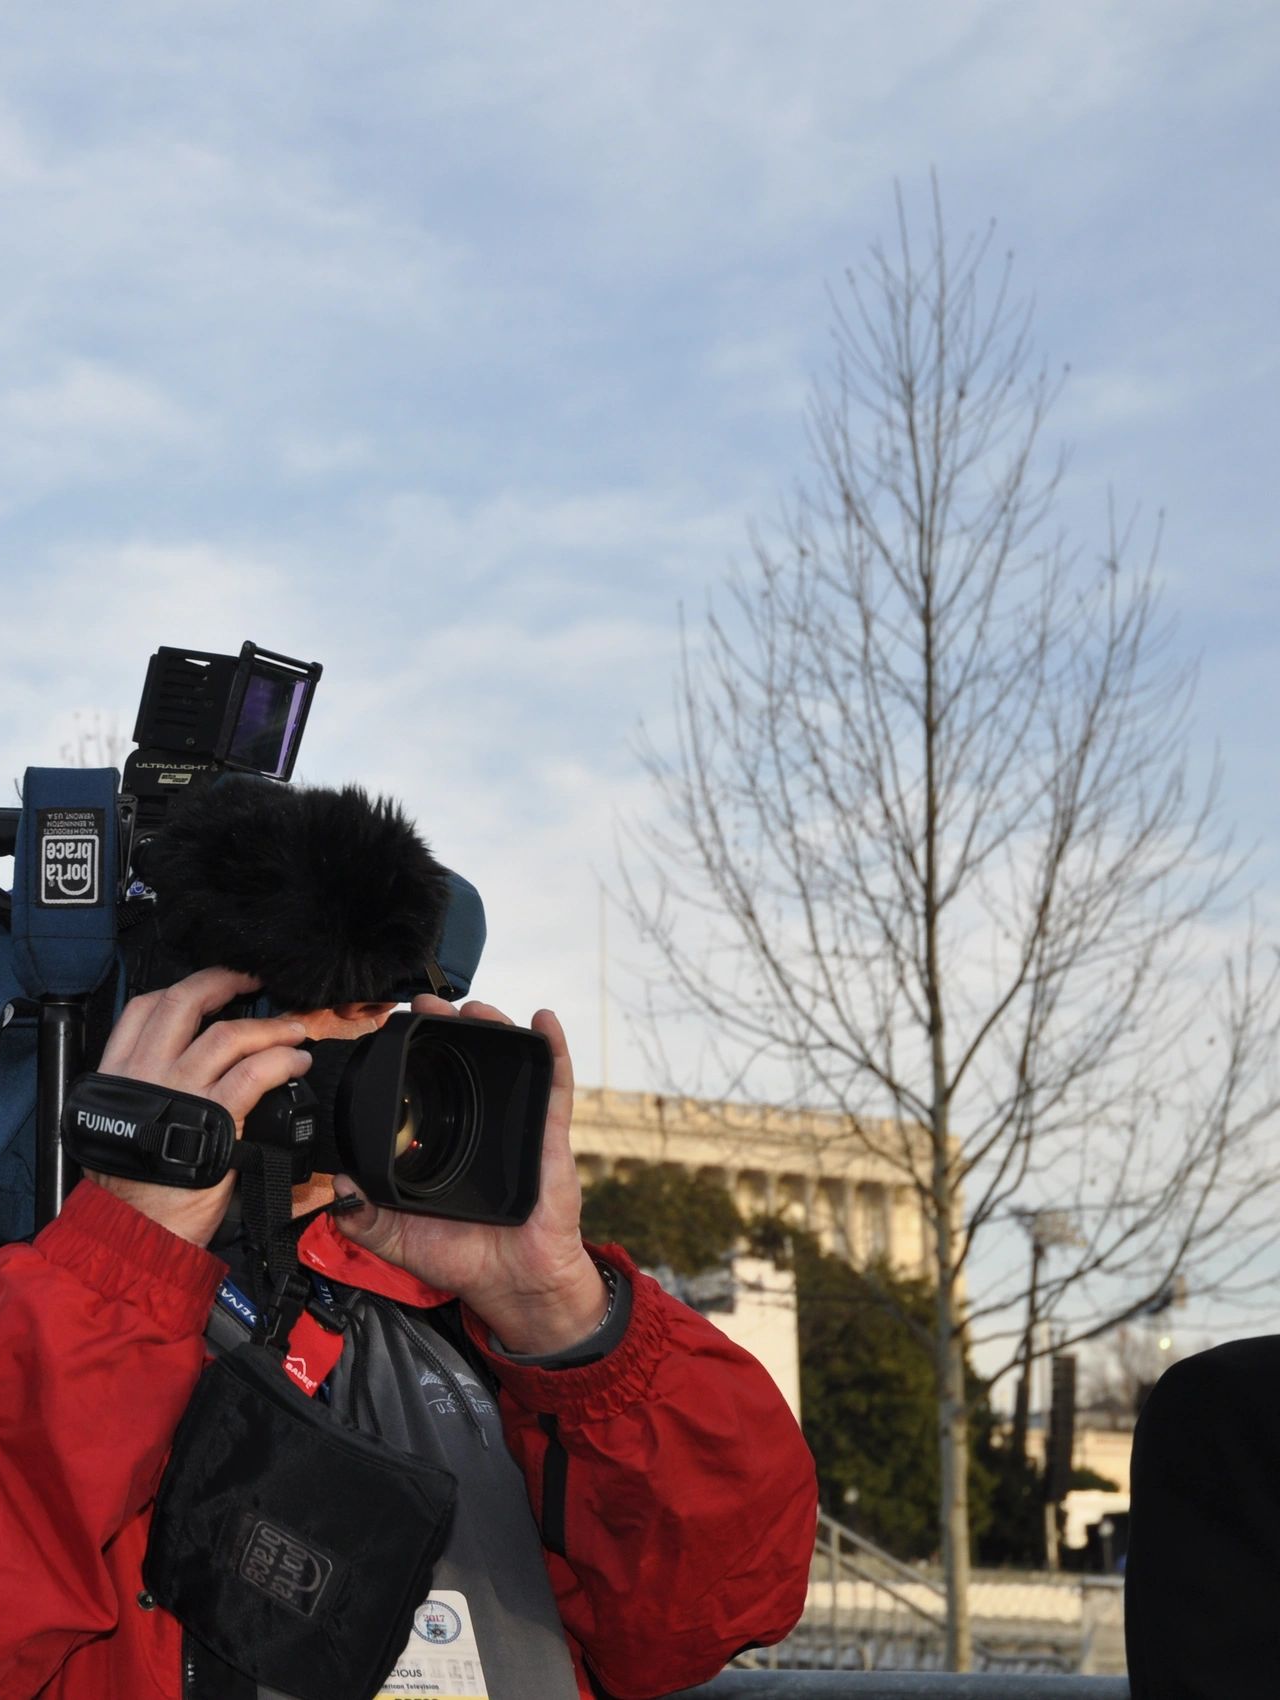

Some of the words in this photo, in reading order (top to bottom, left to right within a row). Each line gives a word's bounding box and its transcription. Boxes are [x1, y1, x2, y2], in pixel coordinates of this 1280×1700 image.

[135, 762, 209, 771] ULTRALIGHT
[46, 820, 87, 828] BENNINGTON
[46, 842, 92, 859] brace
[46, 863, 92, 882] porta
[77, 1110, 136, 1138] FUJINON
[245, 1528, 288, 1583] brace
[423, 1614, 445, 1623] 2017
